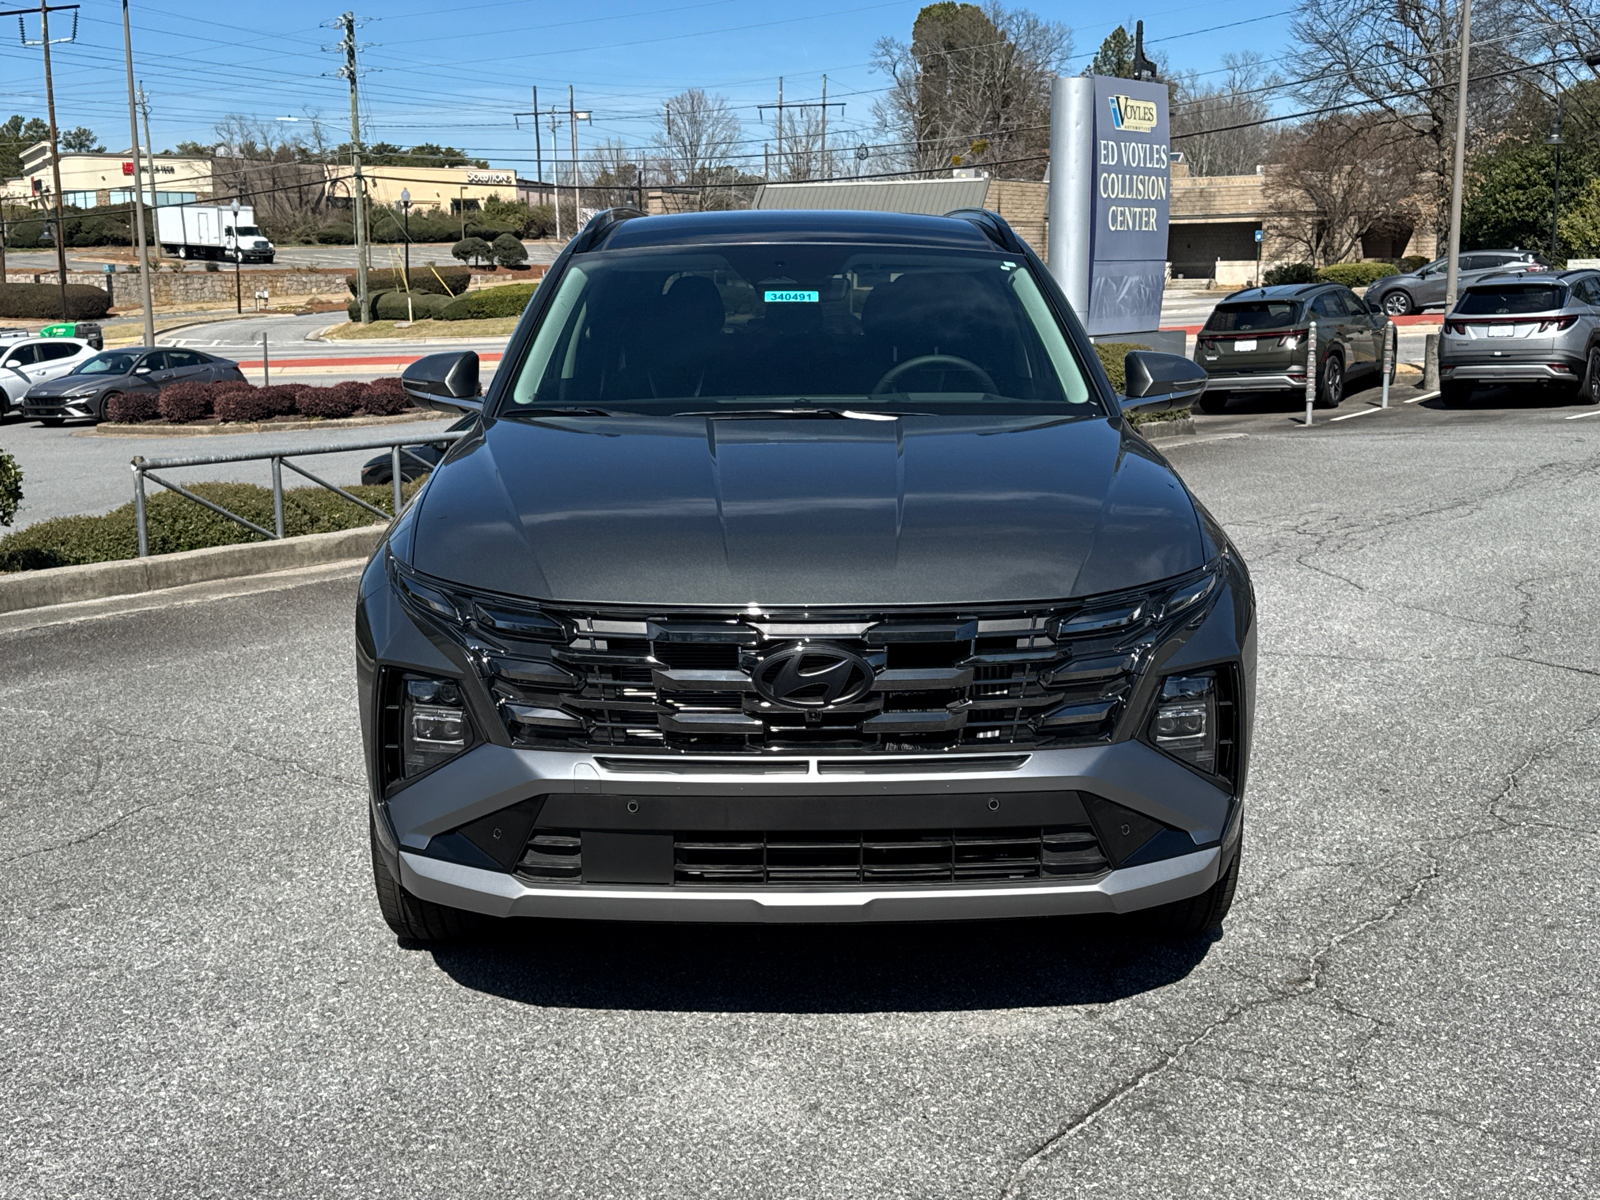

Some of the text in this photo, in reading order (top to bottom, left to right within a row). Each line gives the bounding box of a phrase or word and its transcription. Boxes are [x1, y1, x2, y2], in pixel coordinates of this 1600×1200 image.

[1115, 96, 1154, 125] VOYLES
[1100, 140, 1168, 169] ED VOYLES
[1100, 173, 1167, 200] COLLISION
[1108, 206, 1157, 231] CENTER
[770, 293, 812, 301] 340491
